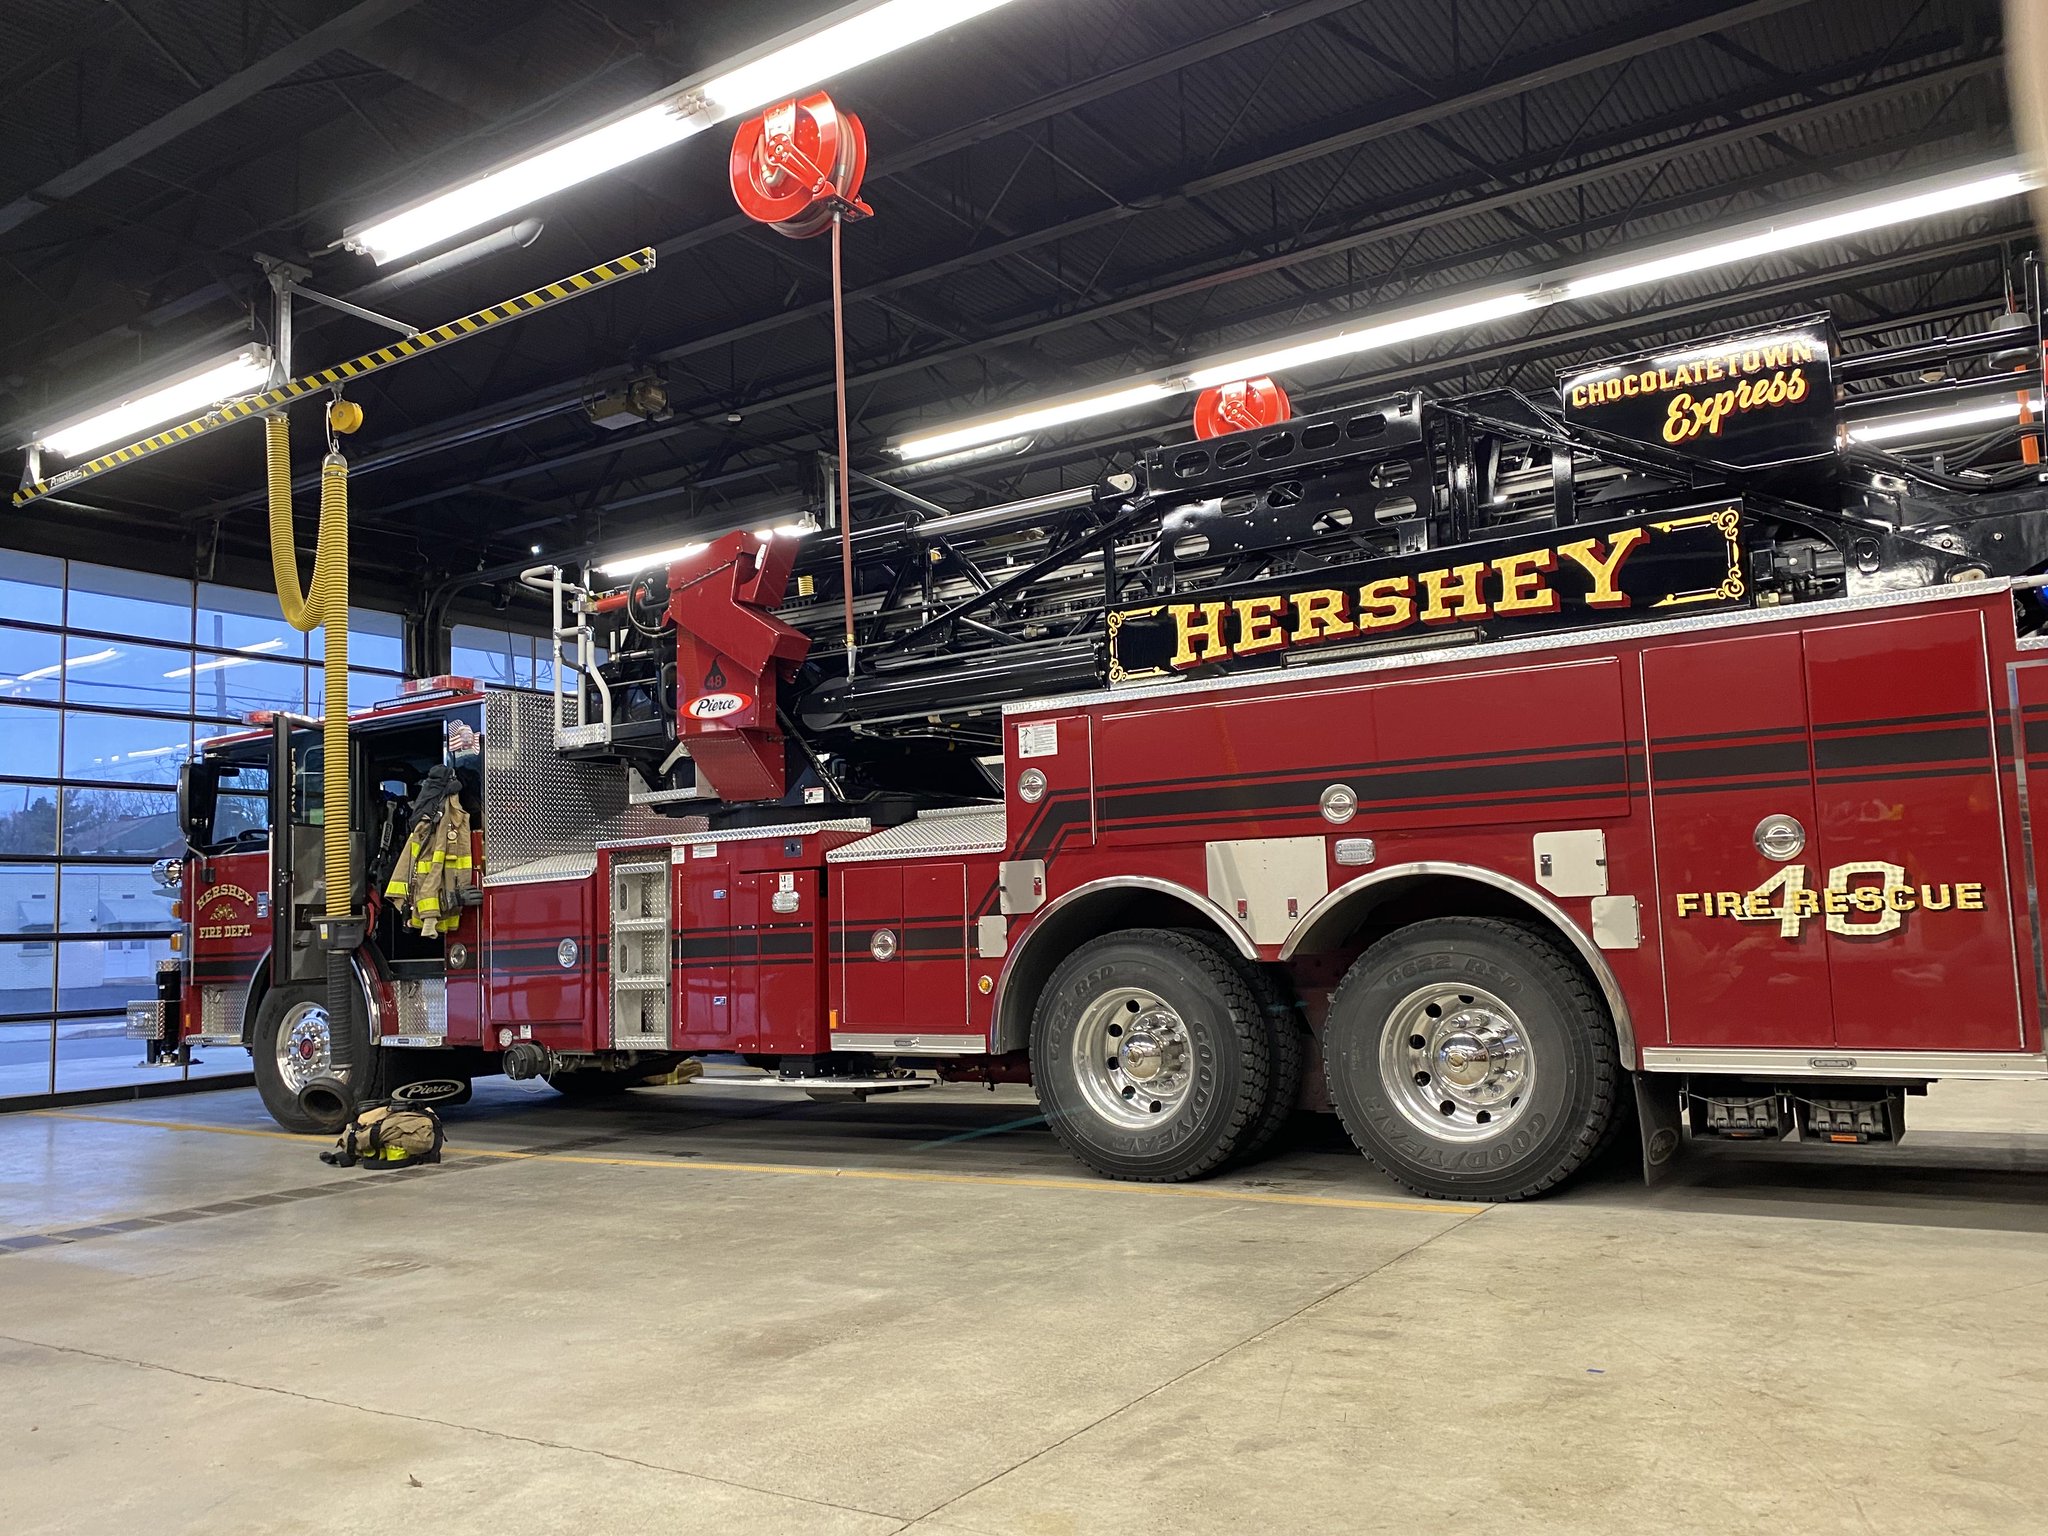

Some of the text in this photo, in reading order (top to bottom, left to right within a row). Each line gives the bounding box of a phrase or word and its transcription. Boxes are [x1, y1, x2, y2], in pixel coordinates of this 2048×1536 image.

[1572, 340, 1813, 407] CHOCOLATETOWN
[1663, 369, 1806, 444] Express
[1168, 527, 1648, 670] HERSHEY
[707, 676, 722, 688] 48
[696, 698, 736, 716] Pierce
[196, 884, 255, 911] HERSHEY
[1676, 882, 1985, 917] FIRE RESCUE
[1728, 860, 1906, 938] 48
[199, 924, 252, 939] FIRE DEPT.
[406, 1084, 455, 1098] Pierce
